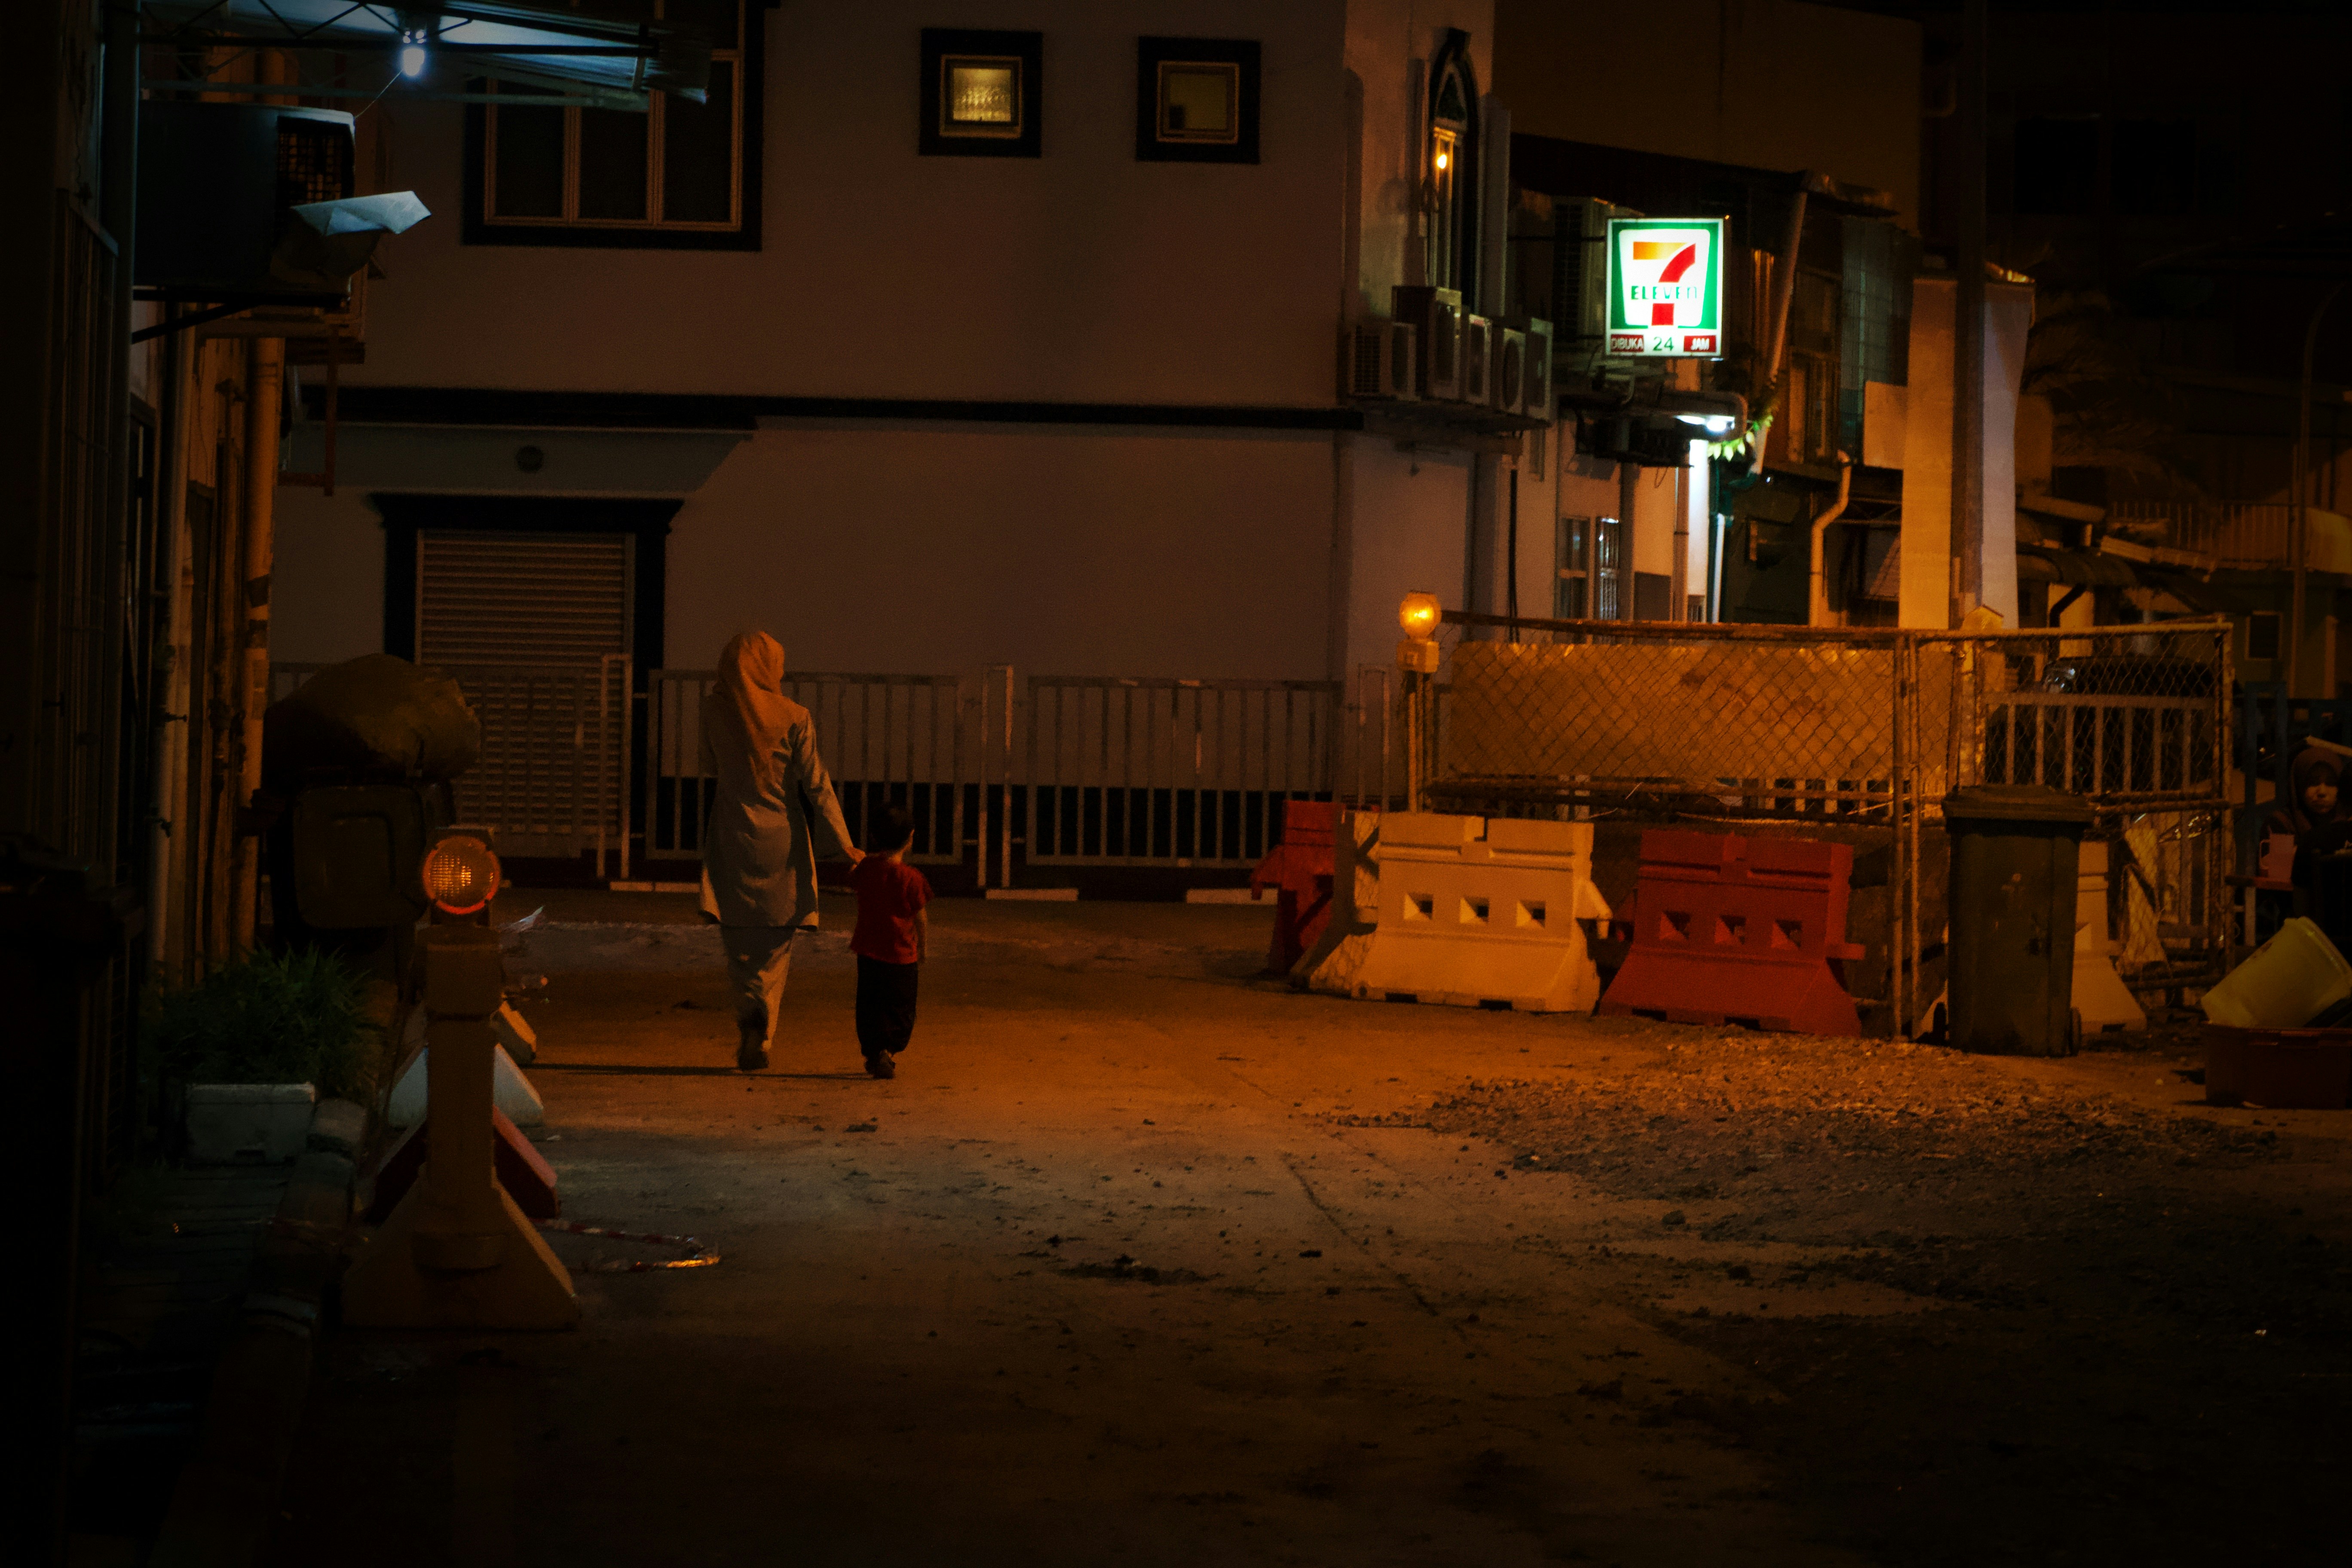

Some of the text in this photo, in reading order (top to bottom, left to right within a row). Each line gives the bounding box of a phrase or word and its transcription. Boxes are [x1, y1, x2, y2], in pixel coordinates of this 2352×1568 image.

[1633, 241, 1696, 326] 7
[1611, 337, 1710, 351] DIBUKA 24 JAM
